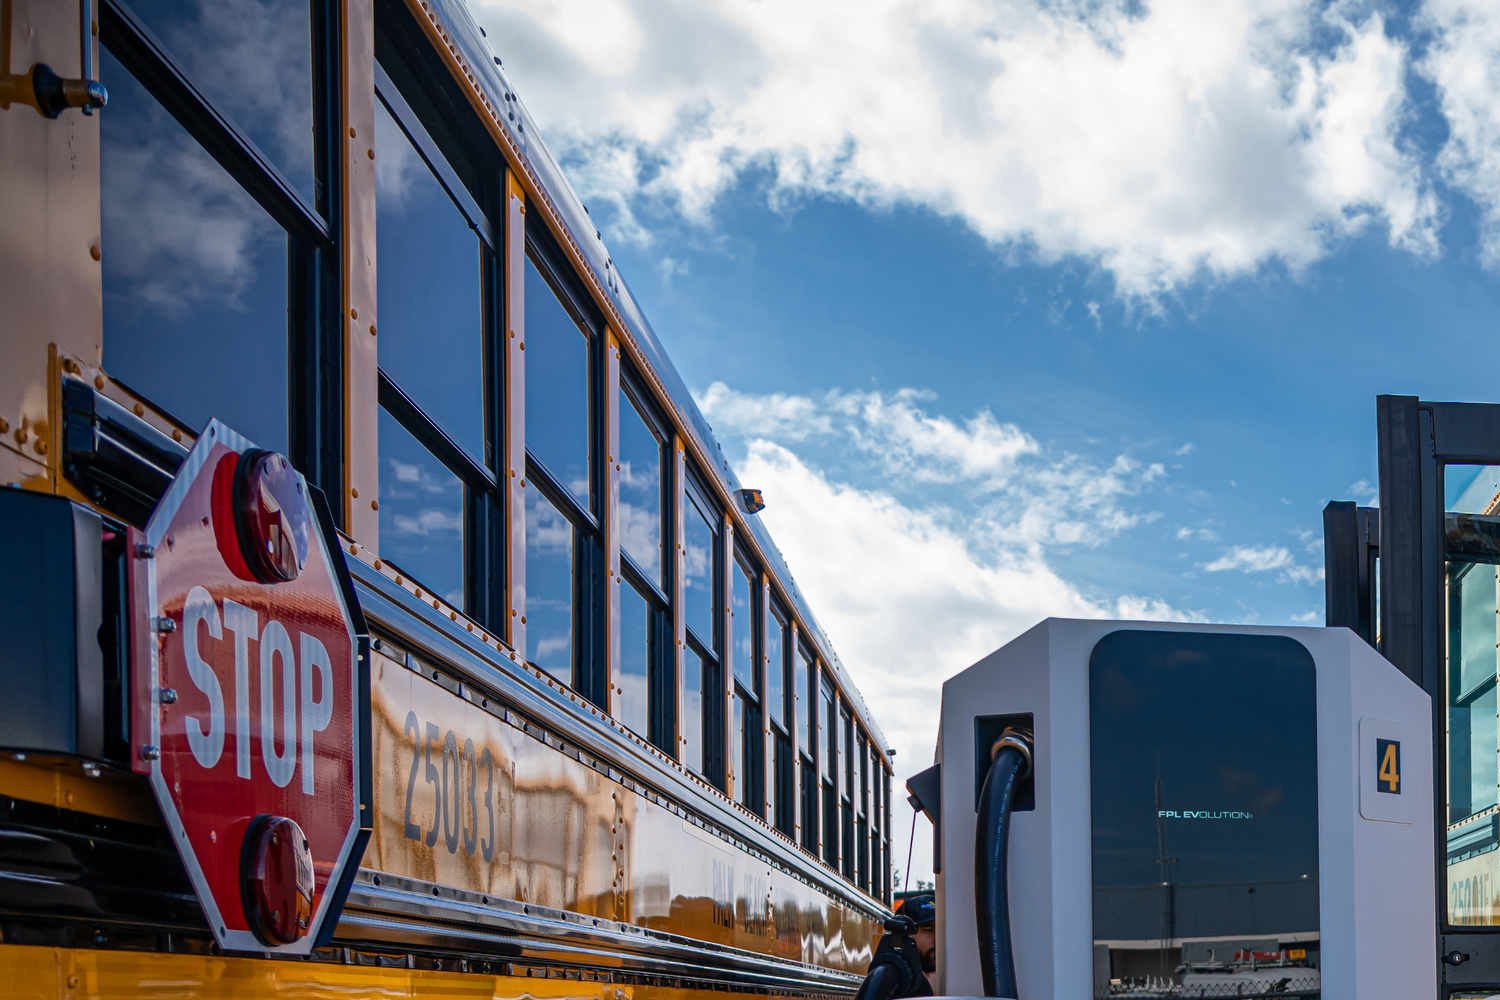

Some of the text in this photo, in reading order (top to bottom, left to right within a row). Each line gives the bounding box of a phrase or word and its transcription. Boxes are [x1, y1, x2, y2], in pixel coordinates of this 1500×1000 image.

[182, 585, 334, 797] STOP
[404, 710, 495, 863] 25033
[1157, 809, 1250, 820] FPL EVOLUTION
[1378, 743, 1400, 792] 4
